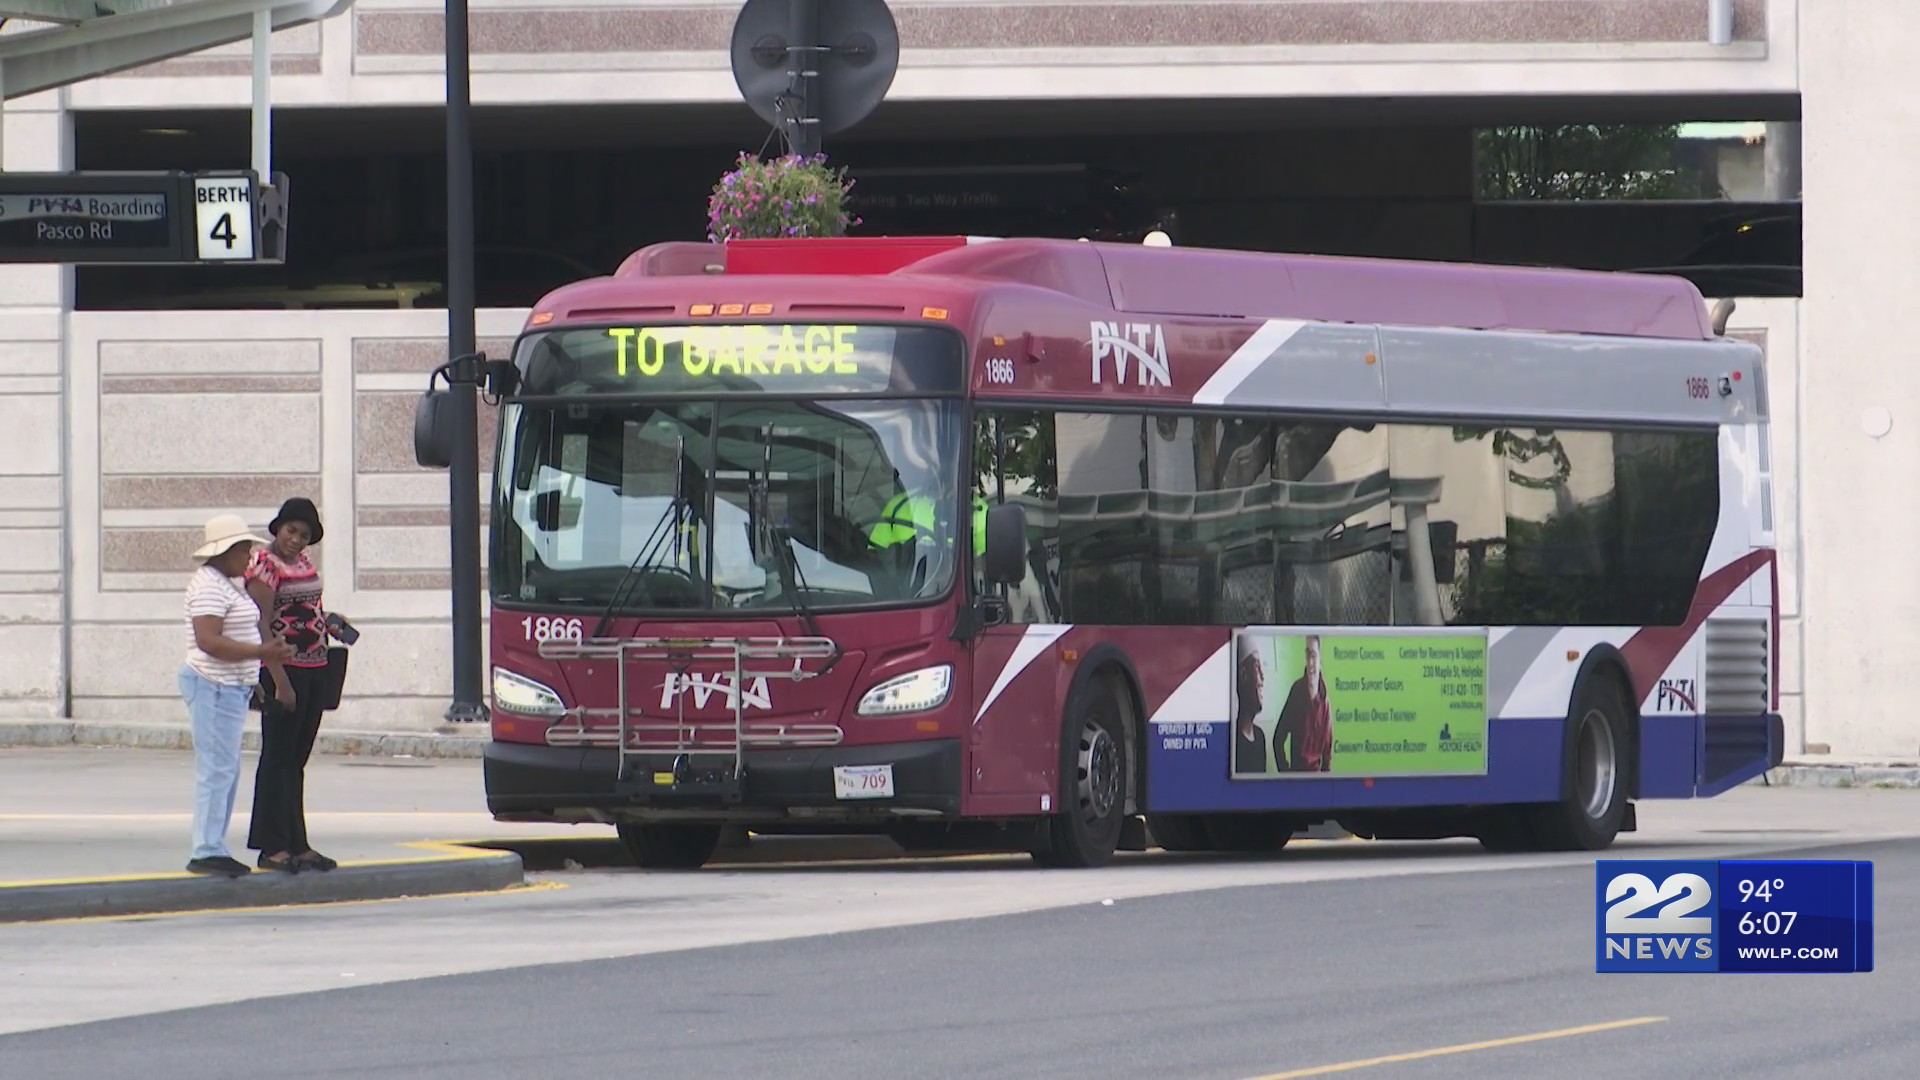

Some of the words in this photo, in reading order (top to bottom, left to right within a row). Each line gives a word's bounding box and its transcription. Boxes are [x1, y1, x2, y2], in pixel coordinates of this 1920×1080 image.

[197, 186, 249, 204] BERTH
[907, 195, 930, 207] Two
[934, 194, 959, 208] Way
[89, 198, 166, 219] Boarding
[37, 222, 84, 241] Pasco
[90, 221, 112, 240] Rd
[210, 212, 237, 250] 4
[608, 327, 665, 376] TO
[682, 325, 858, 376] GARAGE
[1090, 320, 1172, 387] PVTA
[985, 358, 1015, 384] 1866
[1686, 377, 1709, 399] 1866
[521, 616, 583, 641] 1866
[660, 672, 773, 709] PVTA
[1657, 679, 1695, 711] PVTA
[1193, 738, 1207, 749] PVTA
[861, 774, 886, 789] 709
